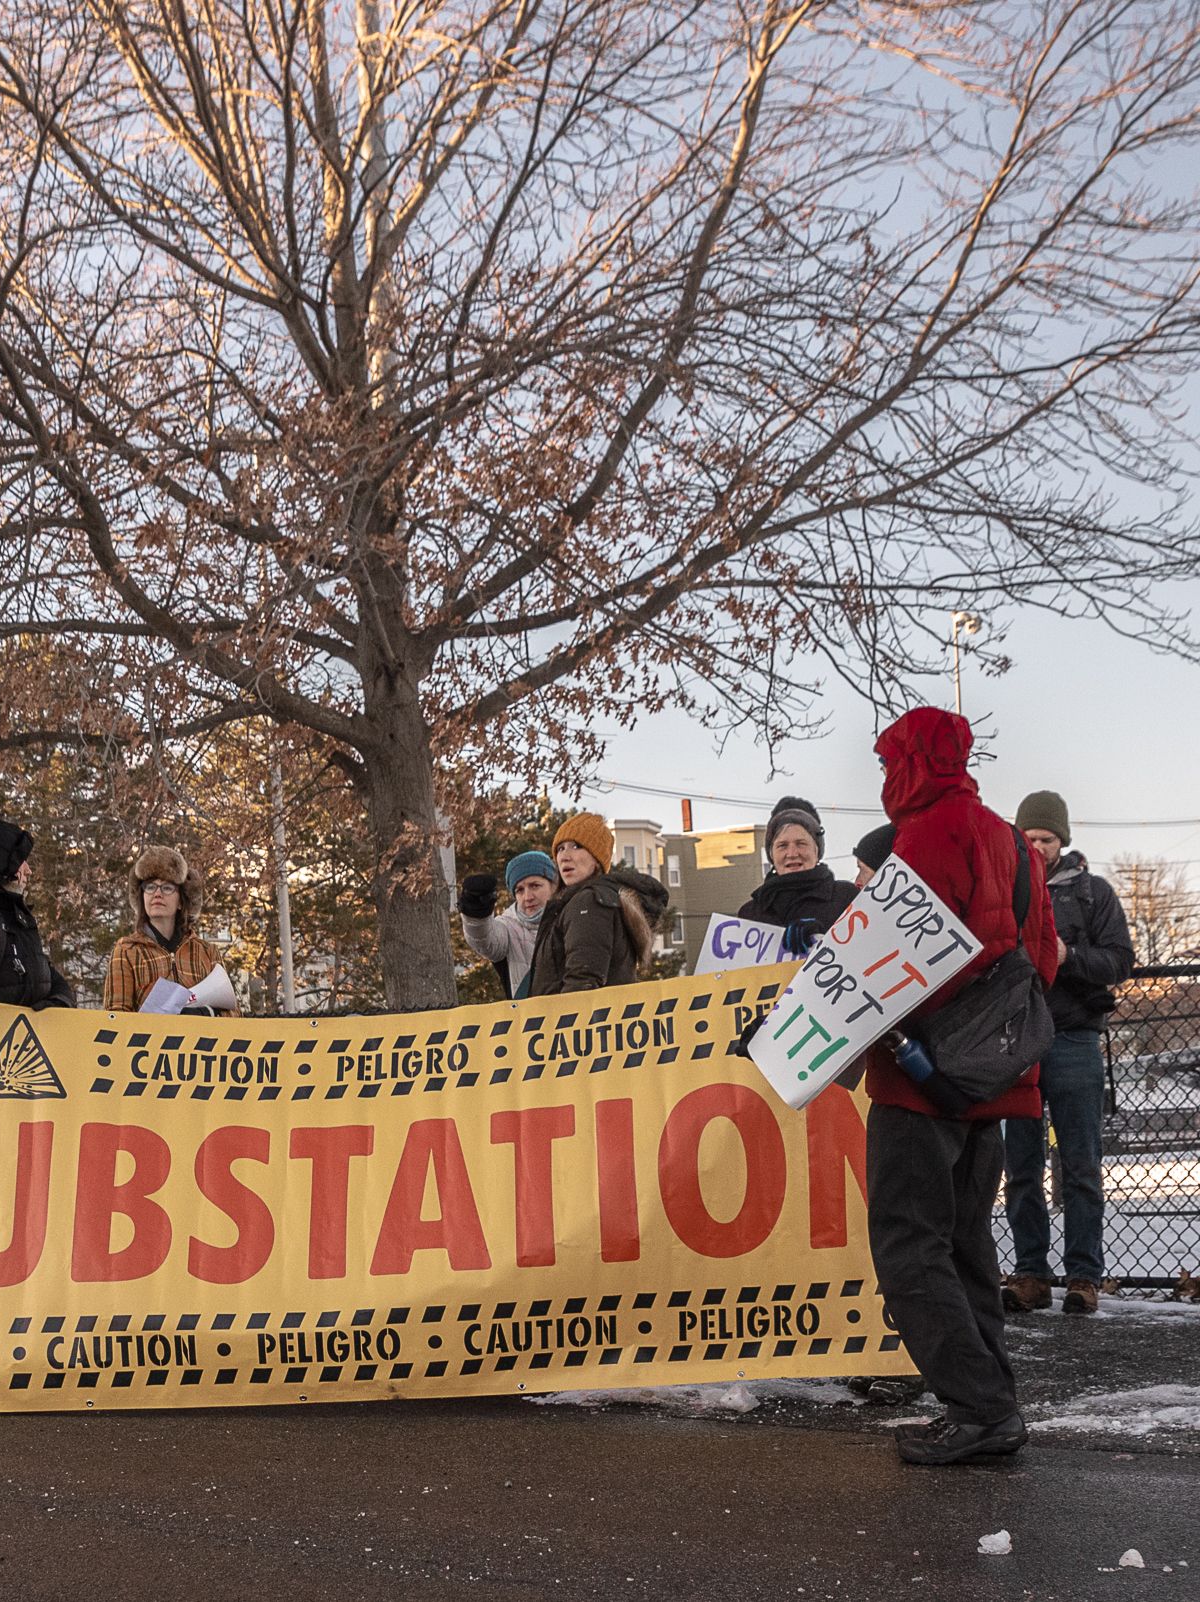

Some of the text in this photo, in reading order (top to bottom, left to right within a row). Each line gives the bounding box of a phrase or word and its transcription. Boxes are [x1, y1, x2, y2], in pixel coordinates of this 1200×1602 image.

[803, 940, 883, 1023] PORT
[863, 949, 928, 1000] IT
[131, 1016, 674, 1083] CAUTION PELIGRO CAUTION
[773, 1004, 849, 1081] IT!
[46, 1303, 820, 1369] CAUTION PELIGRO CAUTION PELIGRO
